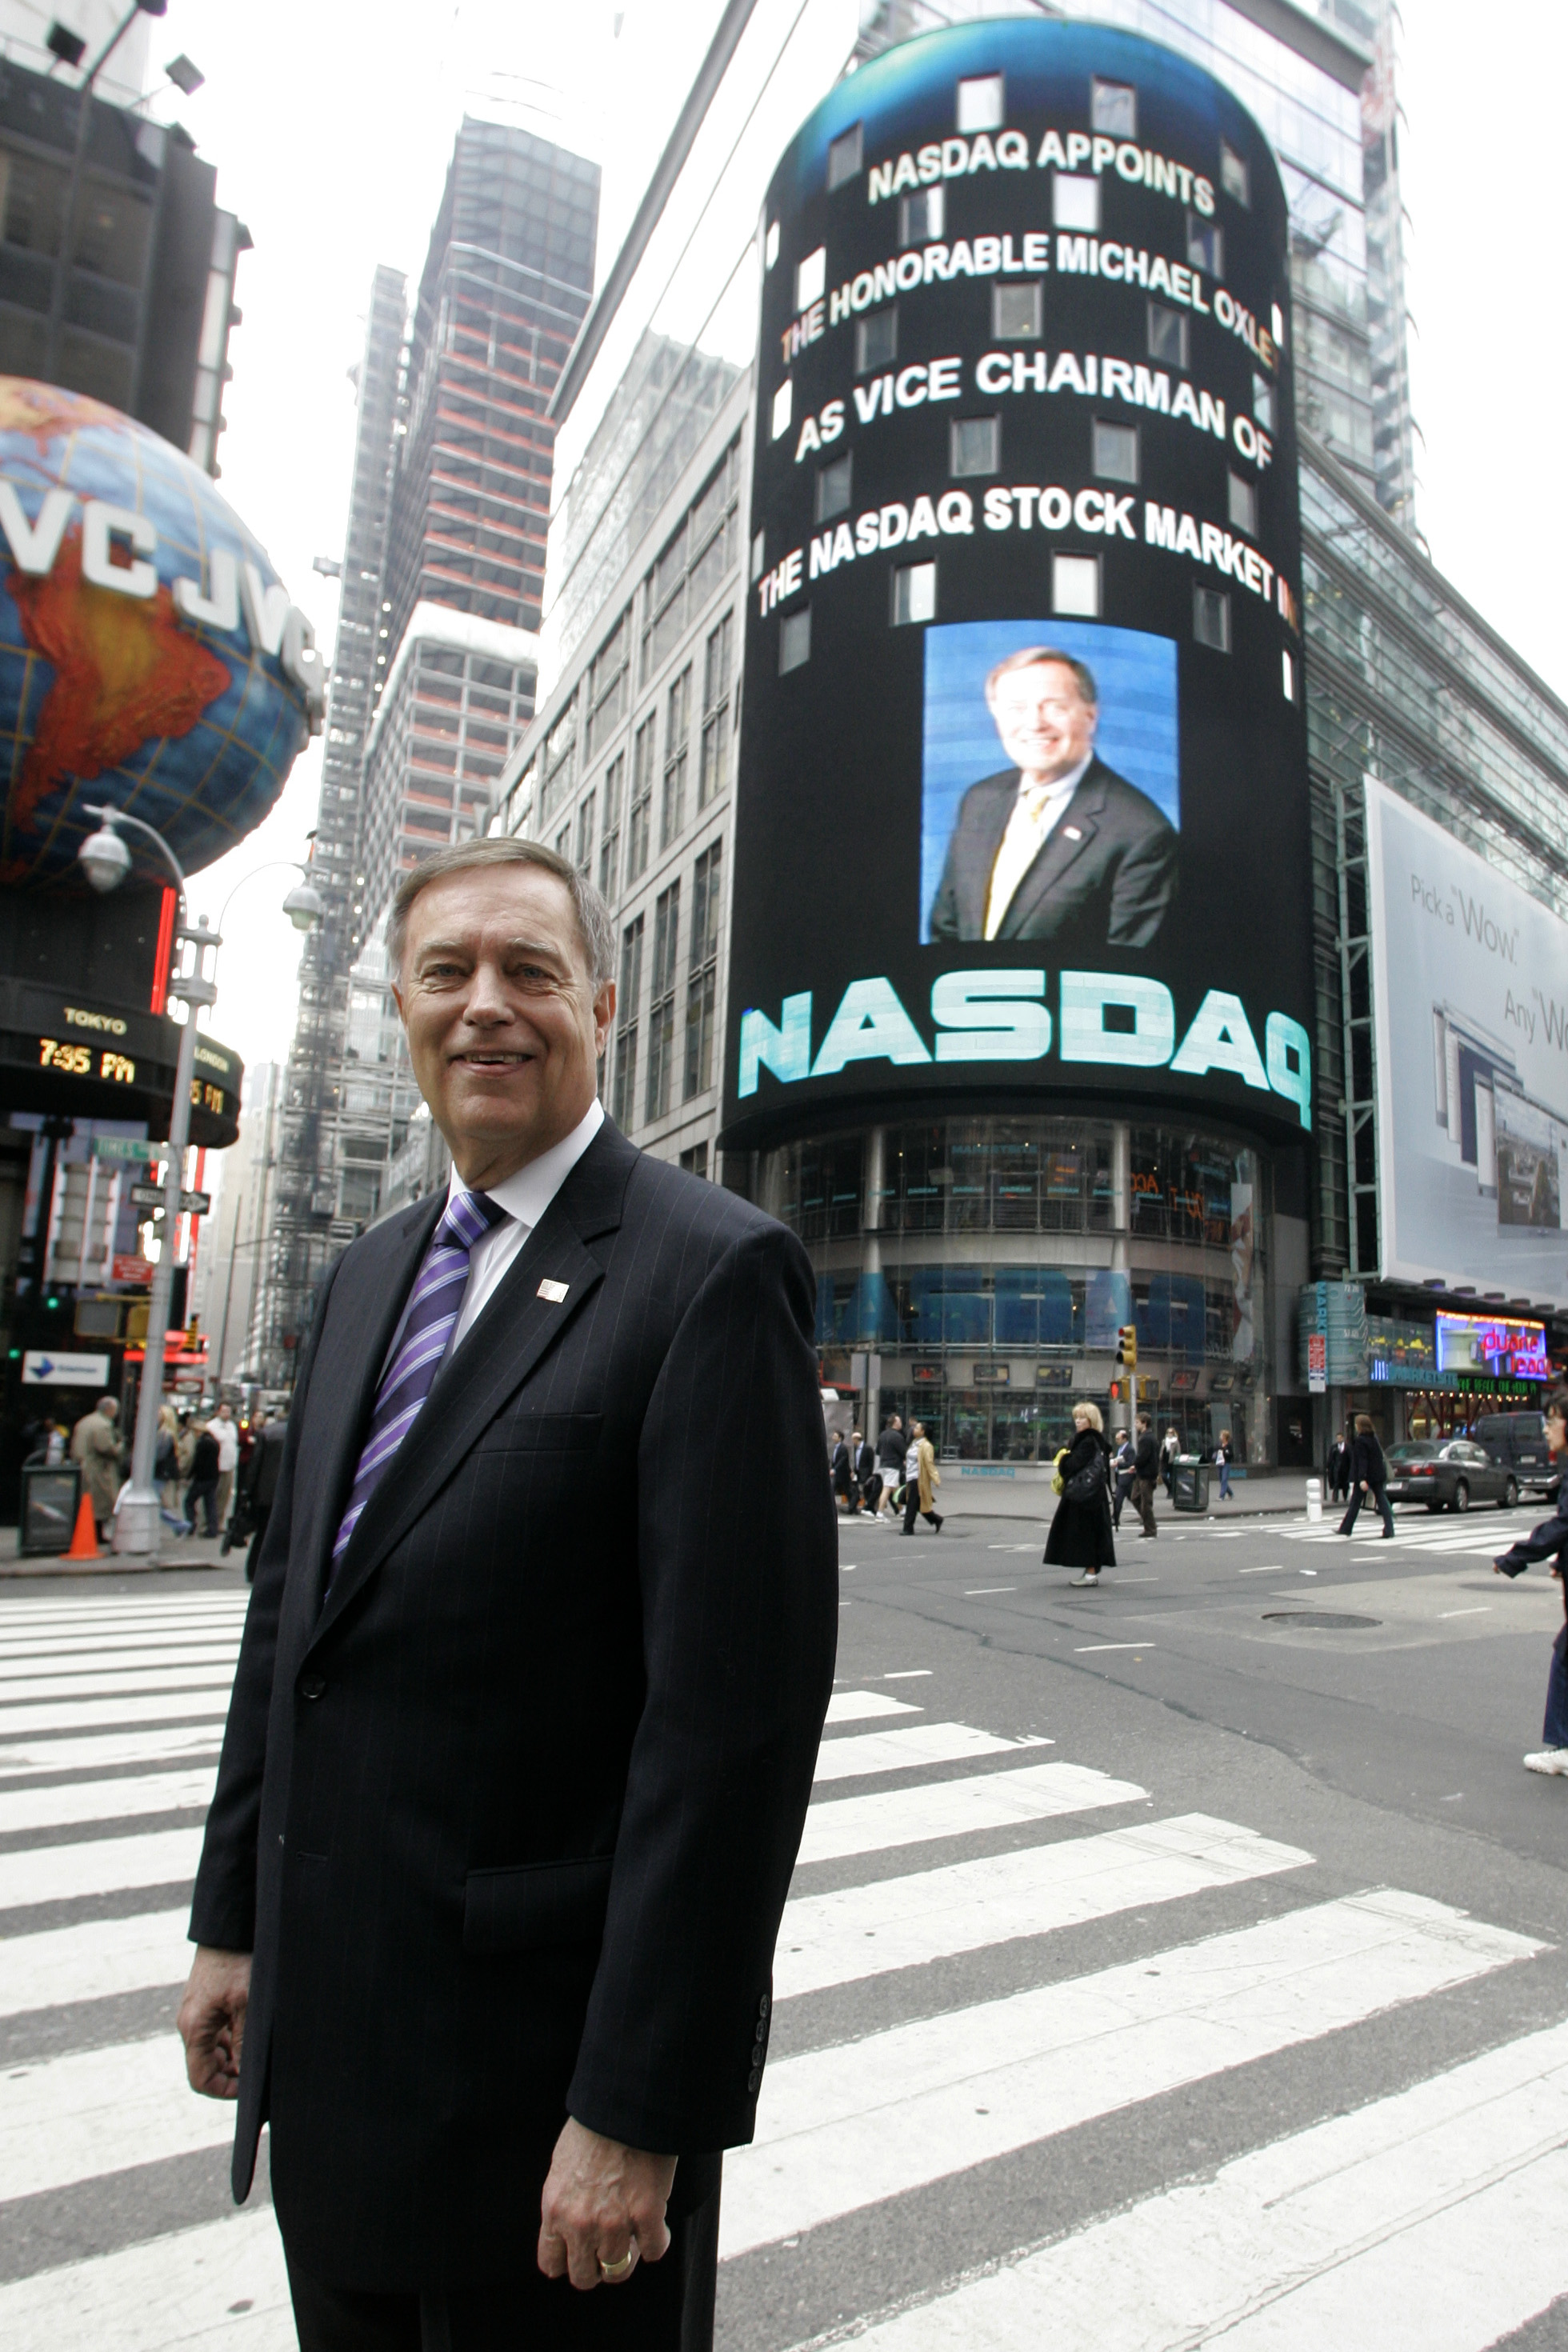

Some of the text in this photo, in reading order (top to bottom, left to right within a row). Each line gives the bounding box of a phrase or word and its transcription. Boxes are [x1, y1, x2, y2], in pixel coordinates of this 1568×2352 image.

[869, 130, 1215, 216] NASDAQ APPOINTS
[782, 301, 826, 364] THE
[830, 233, 1049, 325] HONORABLE
[1057, 235, 1210, 314] MICHAEL
[795, 350, 1274, 470] AS VICE CHAIRMAN OF
[758, 547, 804, 618] THE
[809, 492, 974, 579] NASDAQ
[984, 486, 1138, 541] STOCK
[1144, 502, 1276, 602] MARKET
[1411, 874, 1443, 921] Pick
[1446, 903, 1454, 925] a
[64, 1006, 127, 1035] TOKYO
[738, 968, 1313, 1132] NASDAQ
[1504, 988, 1536, 1045] Any
[101, 1051, 135, 1084] PM
[194, 1045, 230, 1074] LONDON
